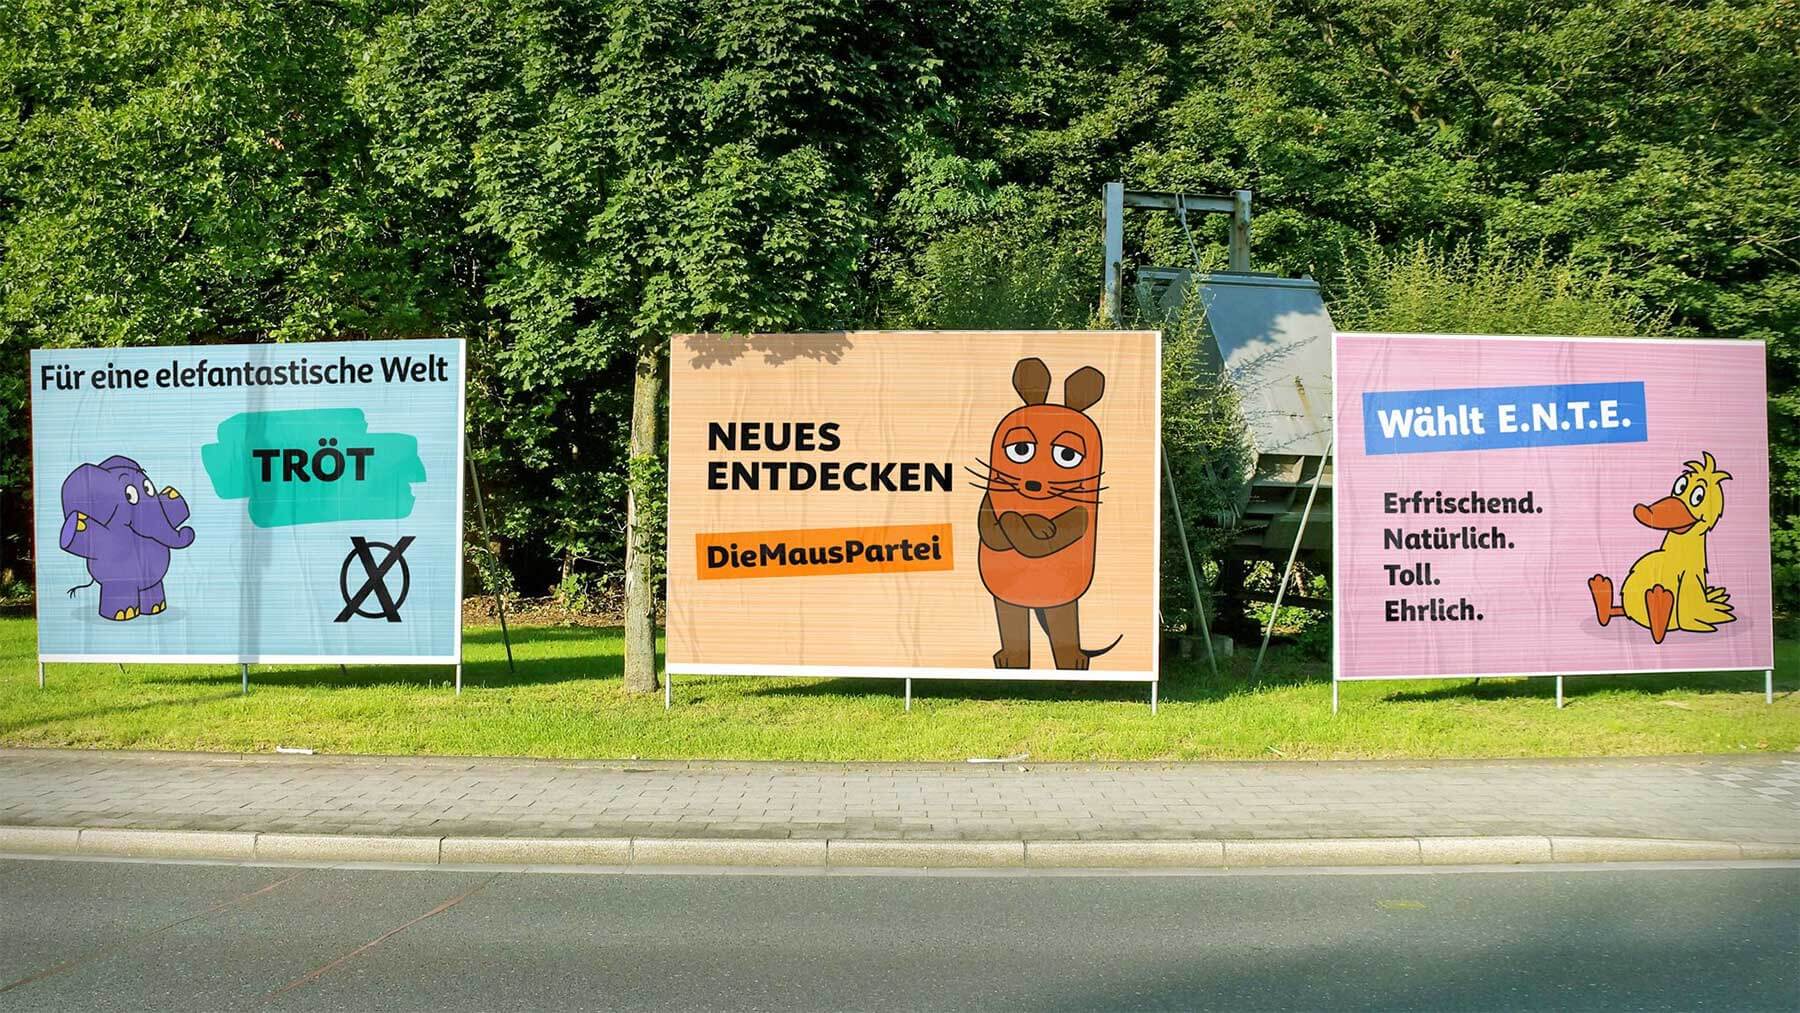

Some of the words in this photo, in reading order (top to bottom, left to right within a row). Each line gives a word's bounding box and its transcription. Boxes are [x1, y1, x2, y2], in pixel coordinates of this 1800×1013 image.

[41, 364, 86, 391] Für
[91, 362, 149, 390] eine
[155, 356, 371, 388] elefantastische
[380, 353, 449, 383] Welt
[1377, 404, 1486, 439] Wählt
[1498, 399, 1632, 434] E.N.T.E.
[708, 422, 841, 452] NEUES
[252, 437, 375, 483] TRÖT
[707, 461, 953, 492] ENTDECKEN
[1384, 490, 1543, 514] Erfrischend.
[707, 535, 942, 569] DieMausPartei
[1384, 526, 1515, 550] Natürlich.
[1383, 562, 1441, 586] Toll.
[1385, 598, 1484, 622] Ehrlich.
